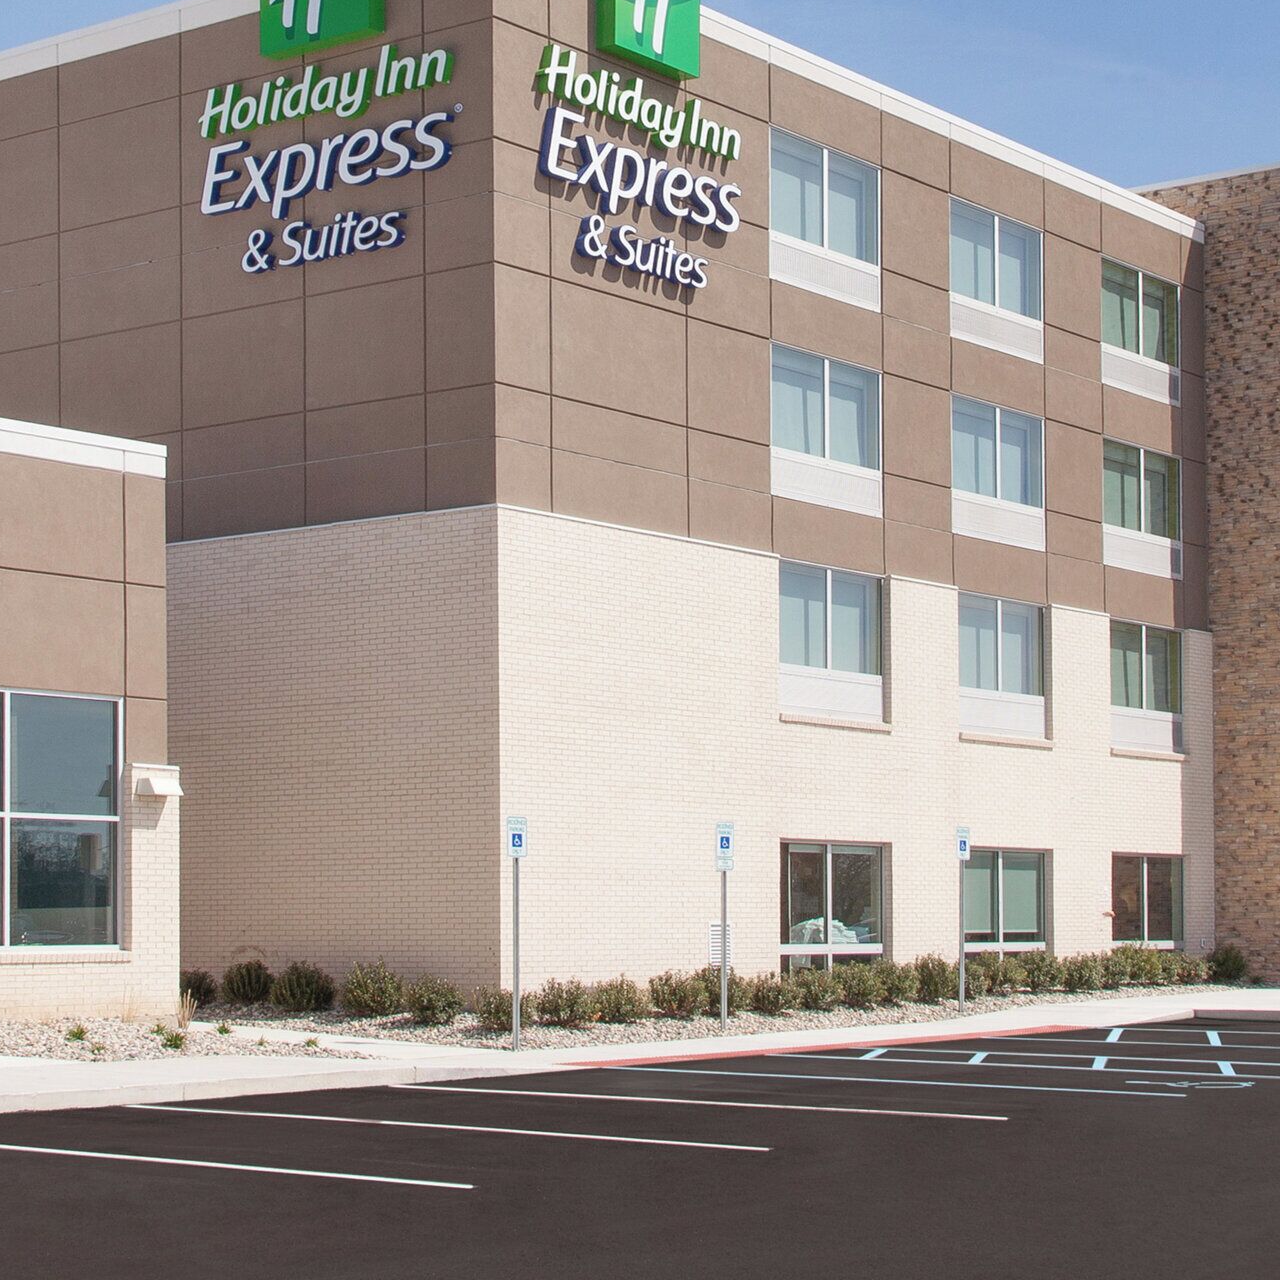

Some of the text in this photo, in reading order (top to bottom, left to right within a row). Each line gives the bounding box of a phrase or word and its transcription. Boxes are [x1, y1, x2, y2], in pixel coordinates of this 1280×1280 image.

[197, 43, 449, 139] Holiday Inn
[544, 43, 742, 160] Holiday Inn
[200, 111, 449, 220] Express
[547, 106, 742, 233] Express
[240, 210, 401, 273] & Suites
[582, 213, 709, 289] & Suites
